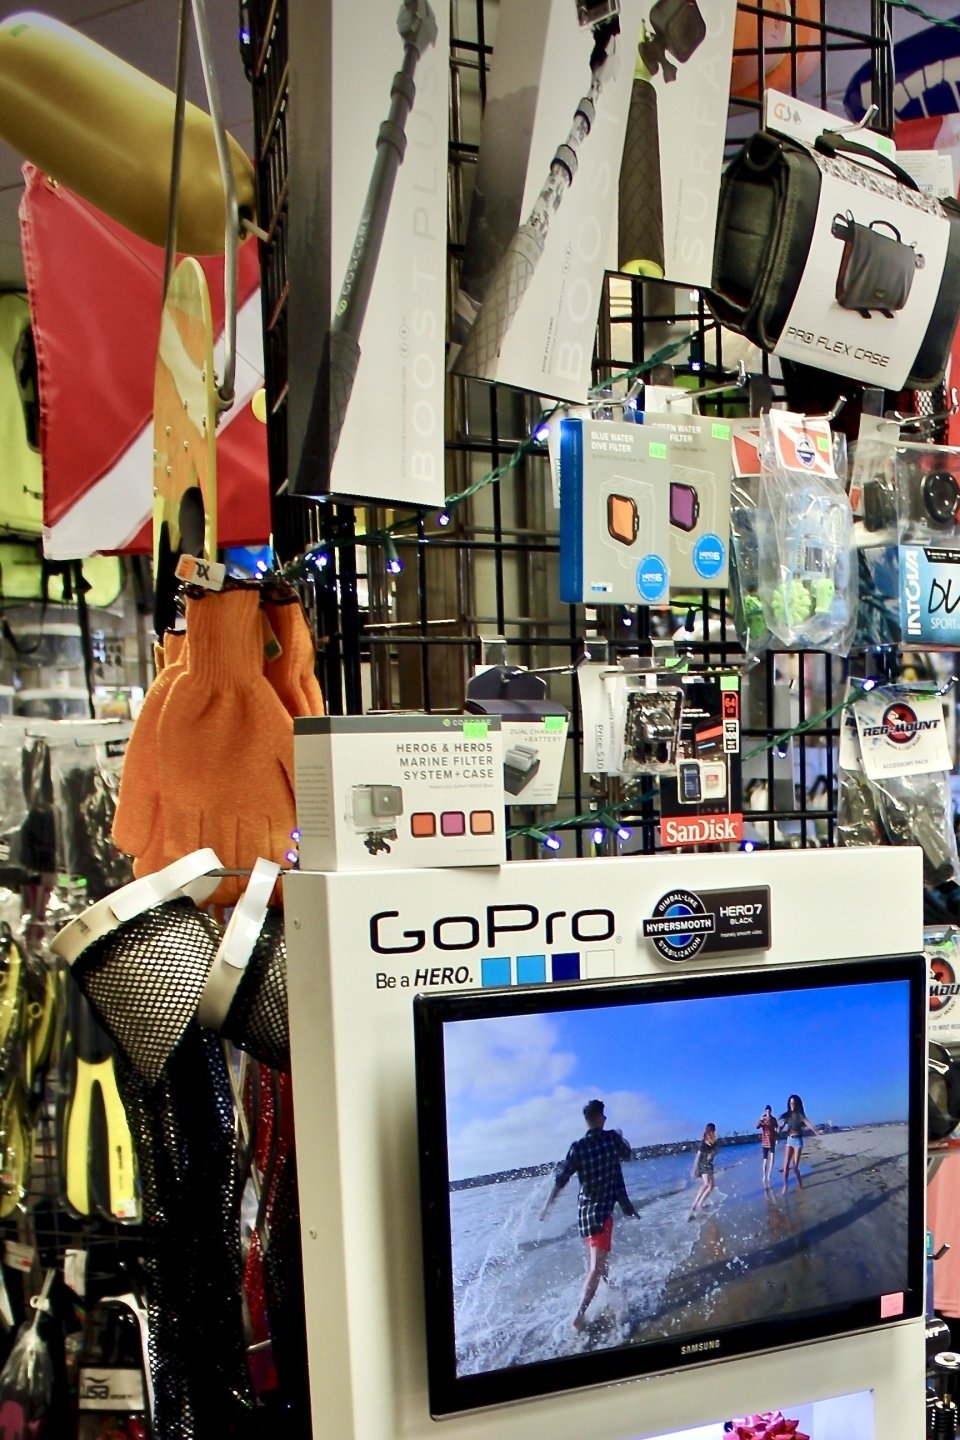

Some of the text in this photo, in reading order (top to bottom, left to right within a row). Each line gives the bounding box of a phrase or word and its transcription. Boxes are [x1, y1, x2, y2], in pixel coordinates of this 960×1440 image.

[411, 63, 440, 483] BOOST PLUS
[785, 326, 890, 368] PRO FLEX CASE
[591, 431, 634, 443] BLUE WATER
[678, 424, 702, 434] WATER
[669, 434, 693, 443] FILTER
[591, 442, 632, 453] DIVE FILTER
[905, 550, 921, 635] INTOVA
[930, 618, 957, 629] SPORT
[596, 724, 604, 748] Price
[396, 743, 493, 753] HERO6 & HERO5
[399, 756, 494, 767] MARINE FILTER
[666, 818, 737, 843] SanDisk
[658, 893, 699, 911] GIMBAL-LIKE
[369, 903, 616, 955] GoPro
[646, 919, 712, 933] HYPERSMOOTH
[729, 917, 754, 925] BLACK
[658, 937, 701, 958] STABILIZATION
[376, 966, 474, 989] Be a HERO.
[681, 1339, 721, 1355] SAMSUNG
